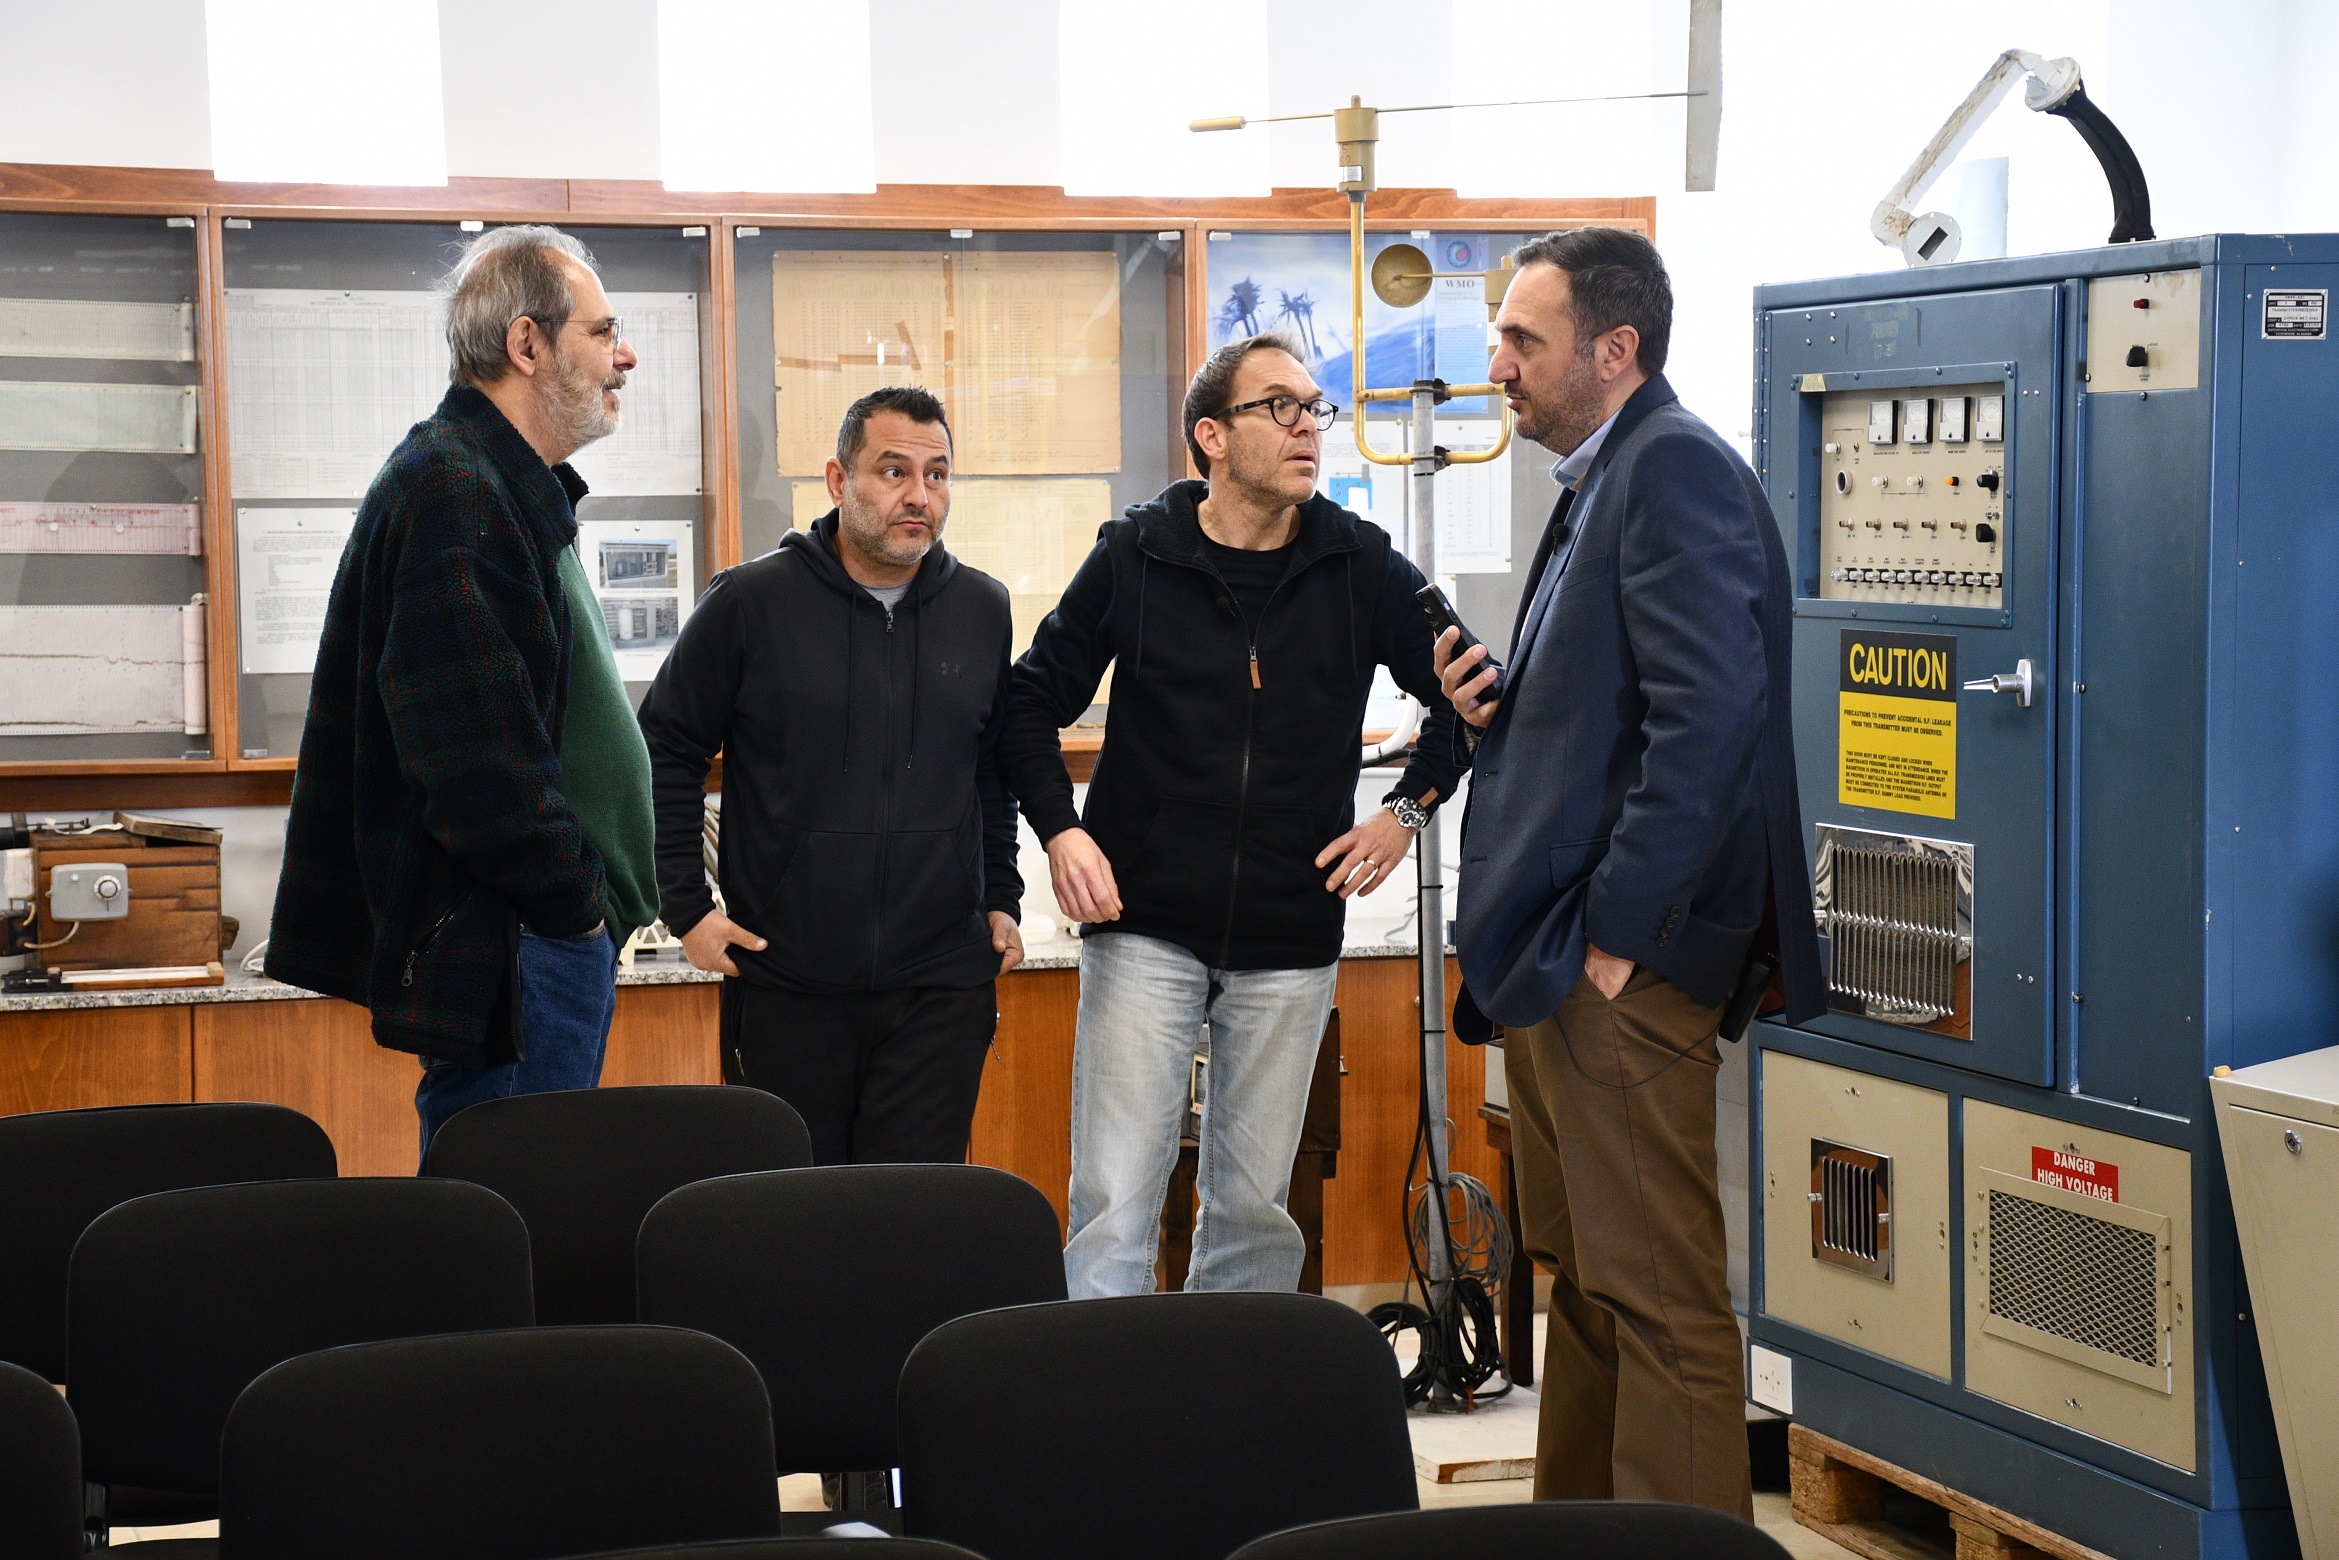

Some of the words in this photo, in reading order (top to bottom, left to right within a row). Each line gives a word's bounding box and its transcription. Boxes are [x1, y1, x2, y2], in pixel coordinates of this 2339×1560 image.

[1445, 279, 1475, 288] WMO
[1849, 642, 1947, 691] CAUTION
[1844, 709, 1871, 718] PRECAUTIONS
[1897, 715, 1922, 723] ACCIDENTAL
[1932, 718, 1951, 726] LEAKAGE
[1873, 723, 1900, 731] TRANSMITTER
[1920, 728, 1943, 736] OBSERVED.
[1846, 757, 1868, 765] MAINTENANCE
[1901, 771, 1925, 780] TRANSMISSION
[1860, 780, 1879, 788] CONNECTED
[1853, 786, 1874, 794] TRANSMITTER
[2053, 1151, 2096, 1176] DANGER
[2037, 1168, 2063, 1188] HIGH
[2066, 1175, 2113, 1202] VOLTAGE
